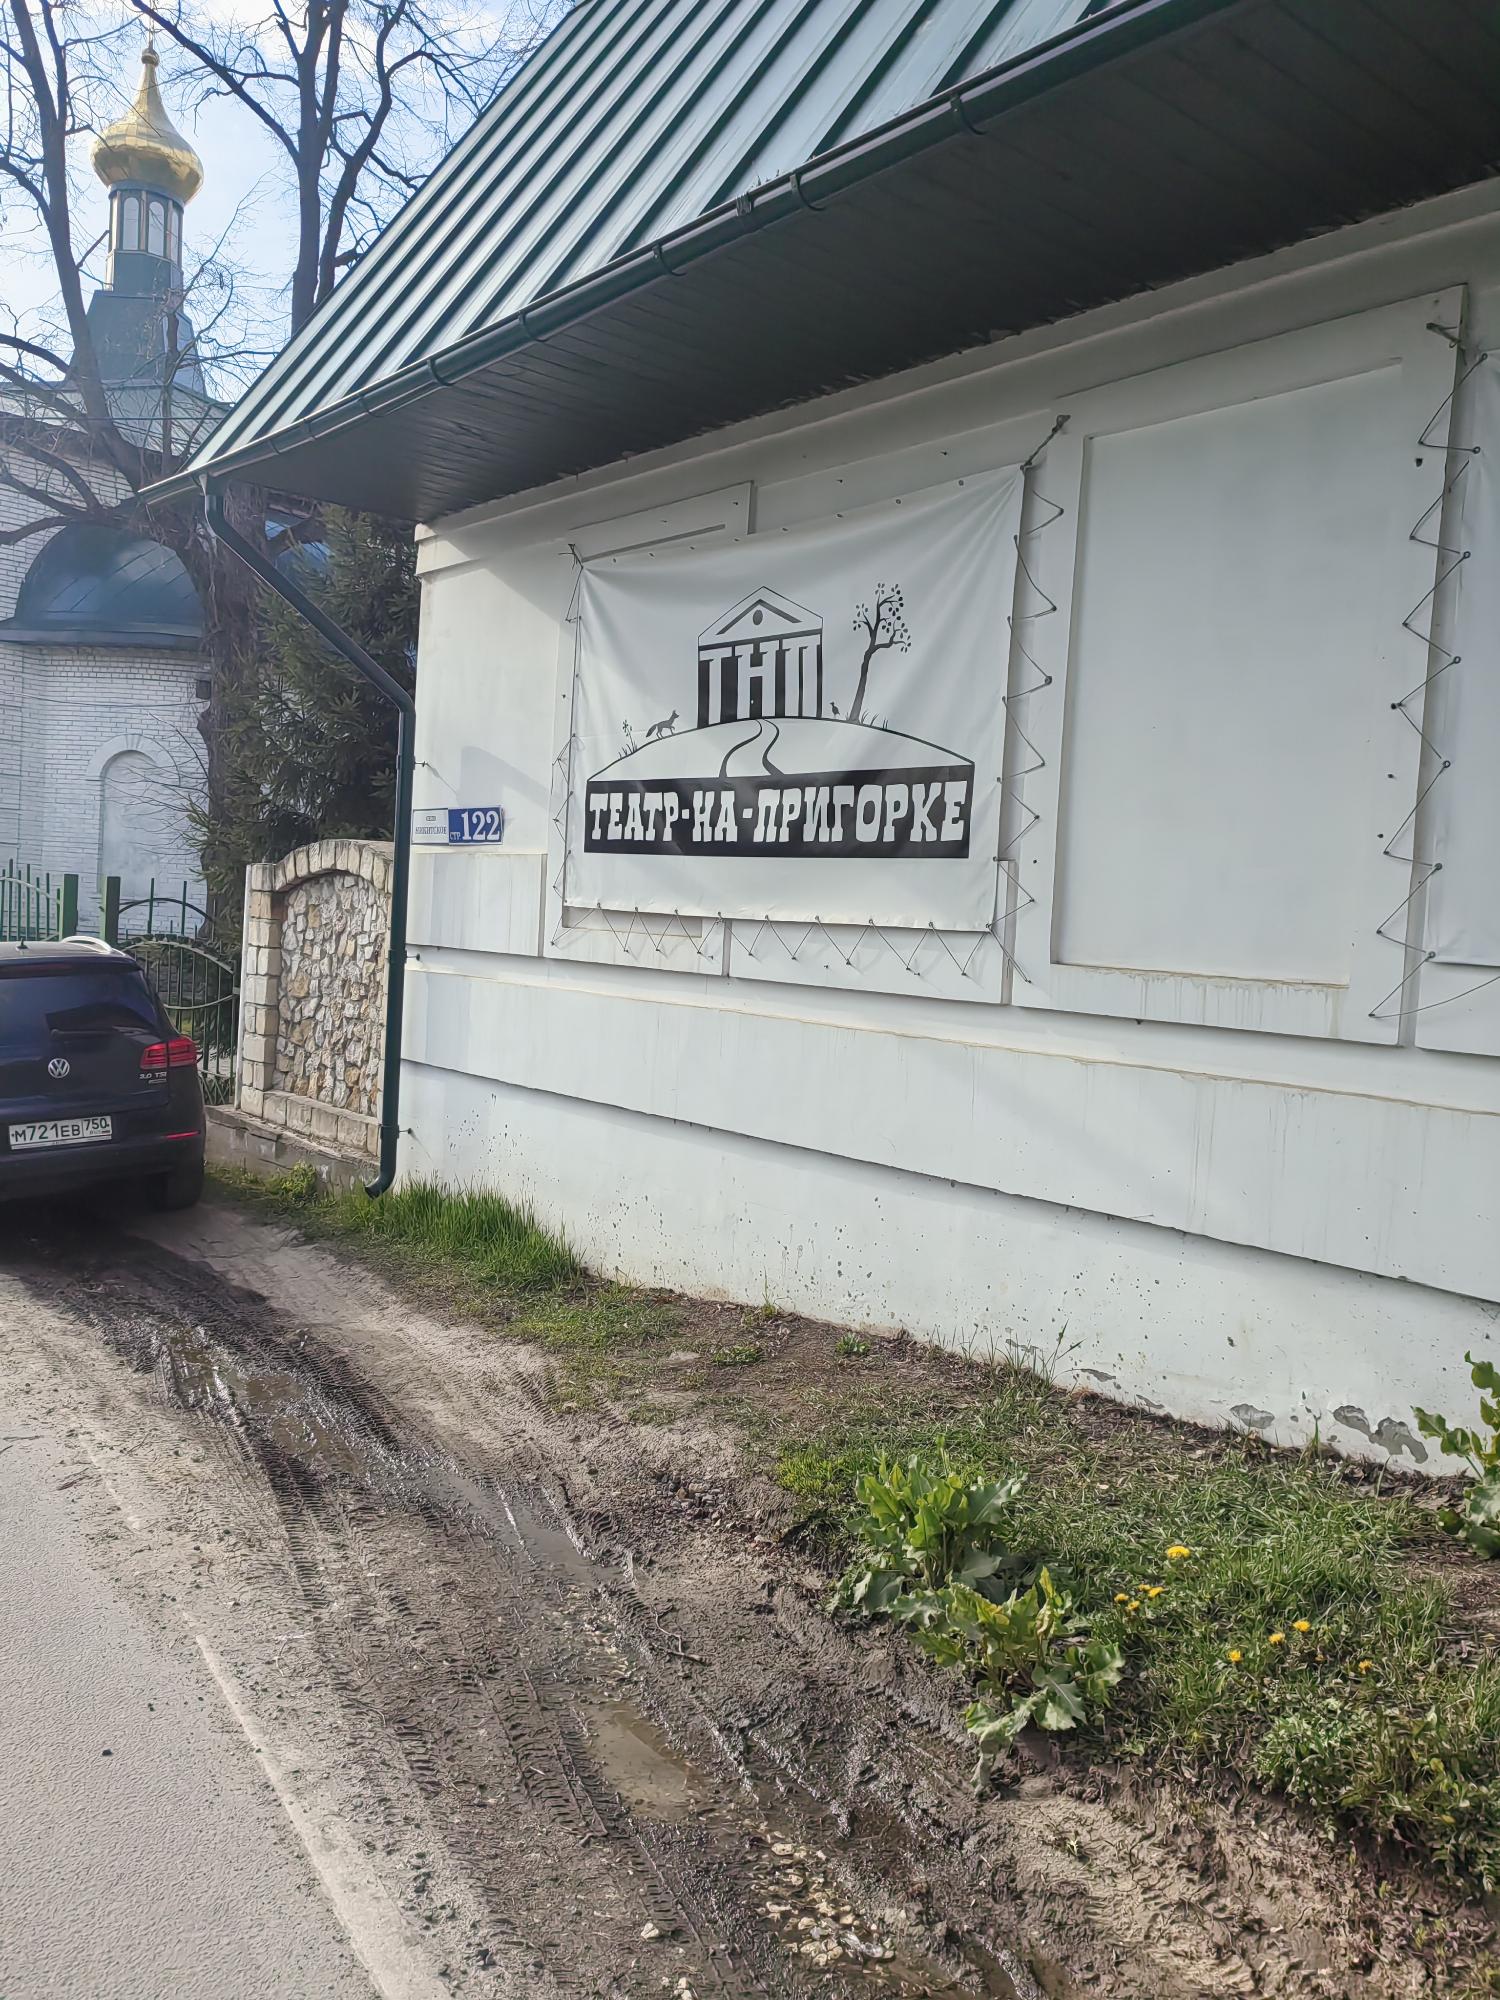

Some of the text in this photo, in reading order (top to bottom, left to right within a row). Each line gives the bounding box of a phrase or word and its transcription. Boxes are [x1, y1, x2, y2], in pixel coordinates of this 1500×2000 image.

[699, 633, 821, 724] ТНП
[461, 811, 500, 840] 122
[588, 780, 968, 843] ТЕАТР-НА-ПРИГОРКЕ
[83, 1118, 107, 1130] 750
